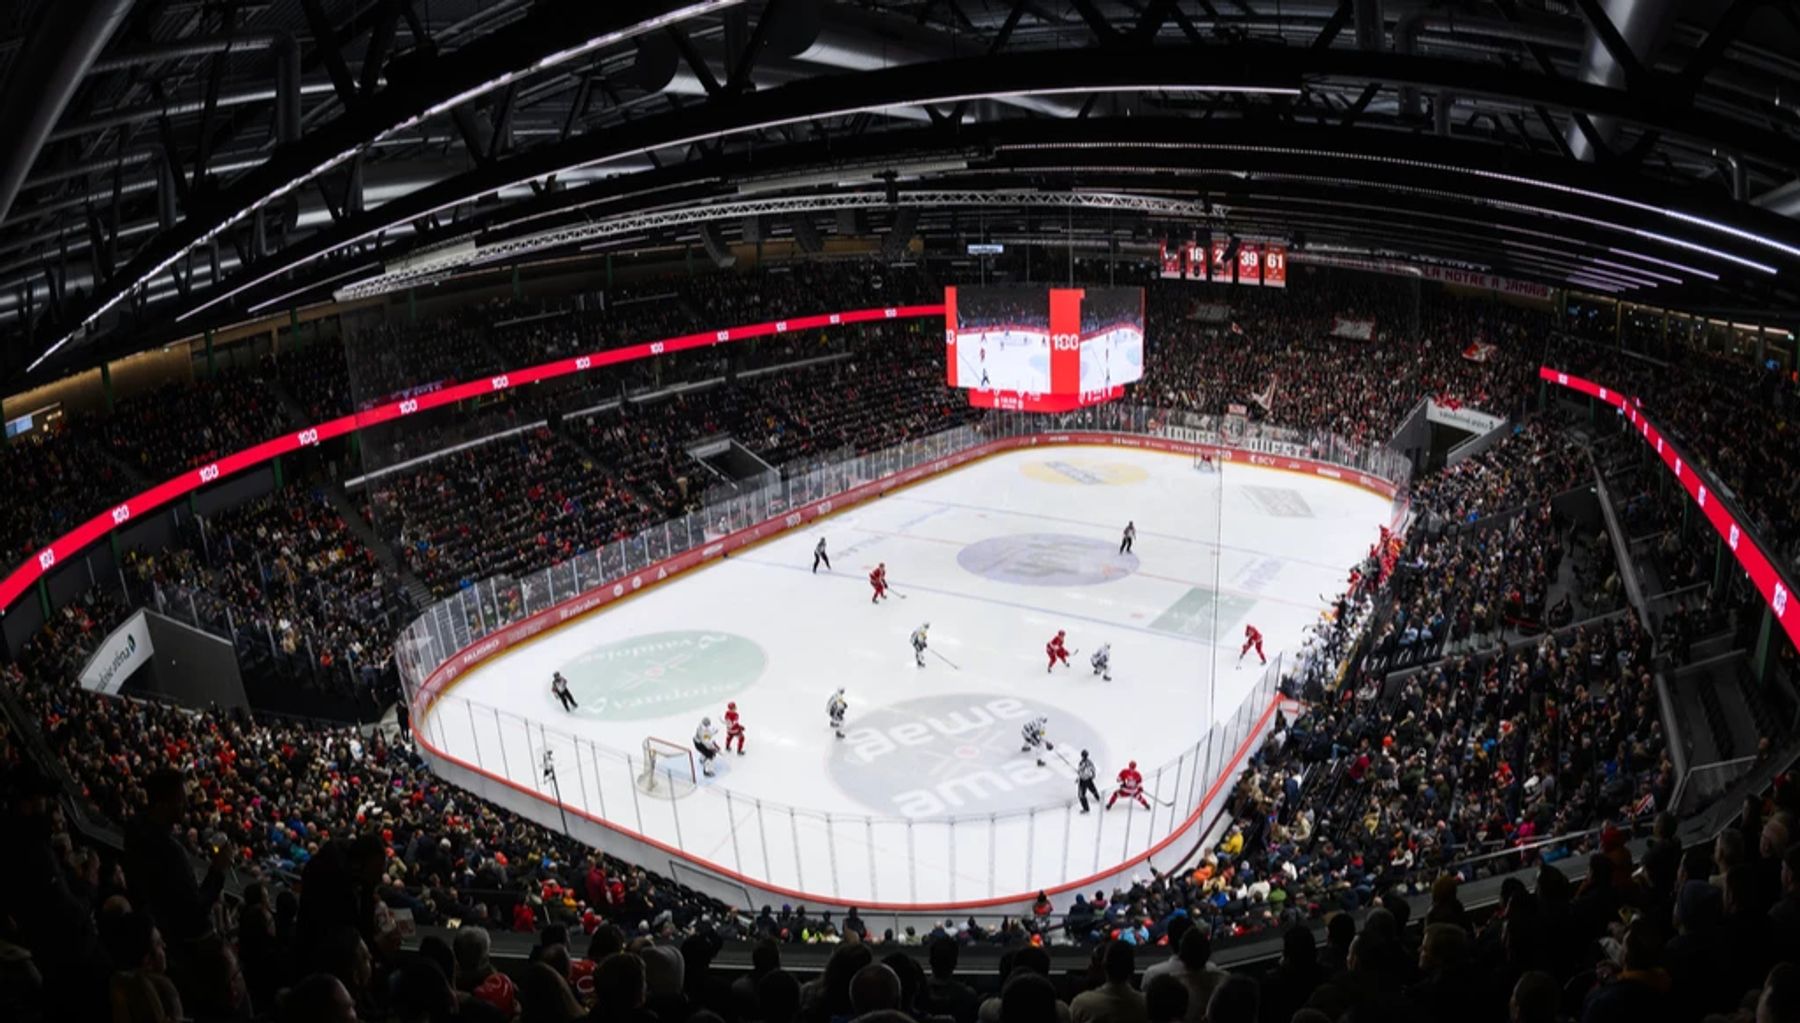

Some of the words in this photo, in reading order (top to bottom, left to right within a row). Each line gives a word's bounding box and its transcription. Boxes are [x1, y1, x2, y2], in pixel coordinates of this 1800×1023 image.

[1189, 247, 1204, 262] 16
[1240, 251, 1258, 267] 39
[1267, 253, 1283, 269] 61
[775, 321, 787, 332] 100
[829, 314, 840, 324] 100
[716, 331, 729, 342] 100
[1052, 334, 1080, 351] 100
[650, 341, 664, 354] 100
[575, 356, 590, 370] 100
[491, 375, 509, 389] 100
[399, 399, 418, 415] 100
[298, 428, 319, 446] 100
[199, 463, 219, 483] 100
[112, 504, 130, 524] 100
